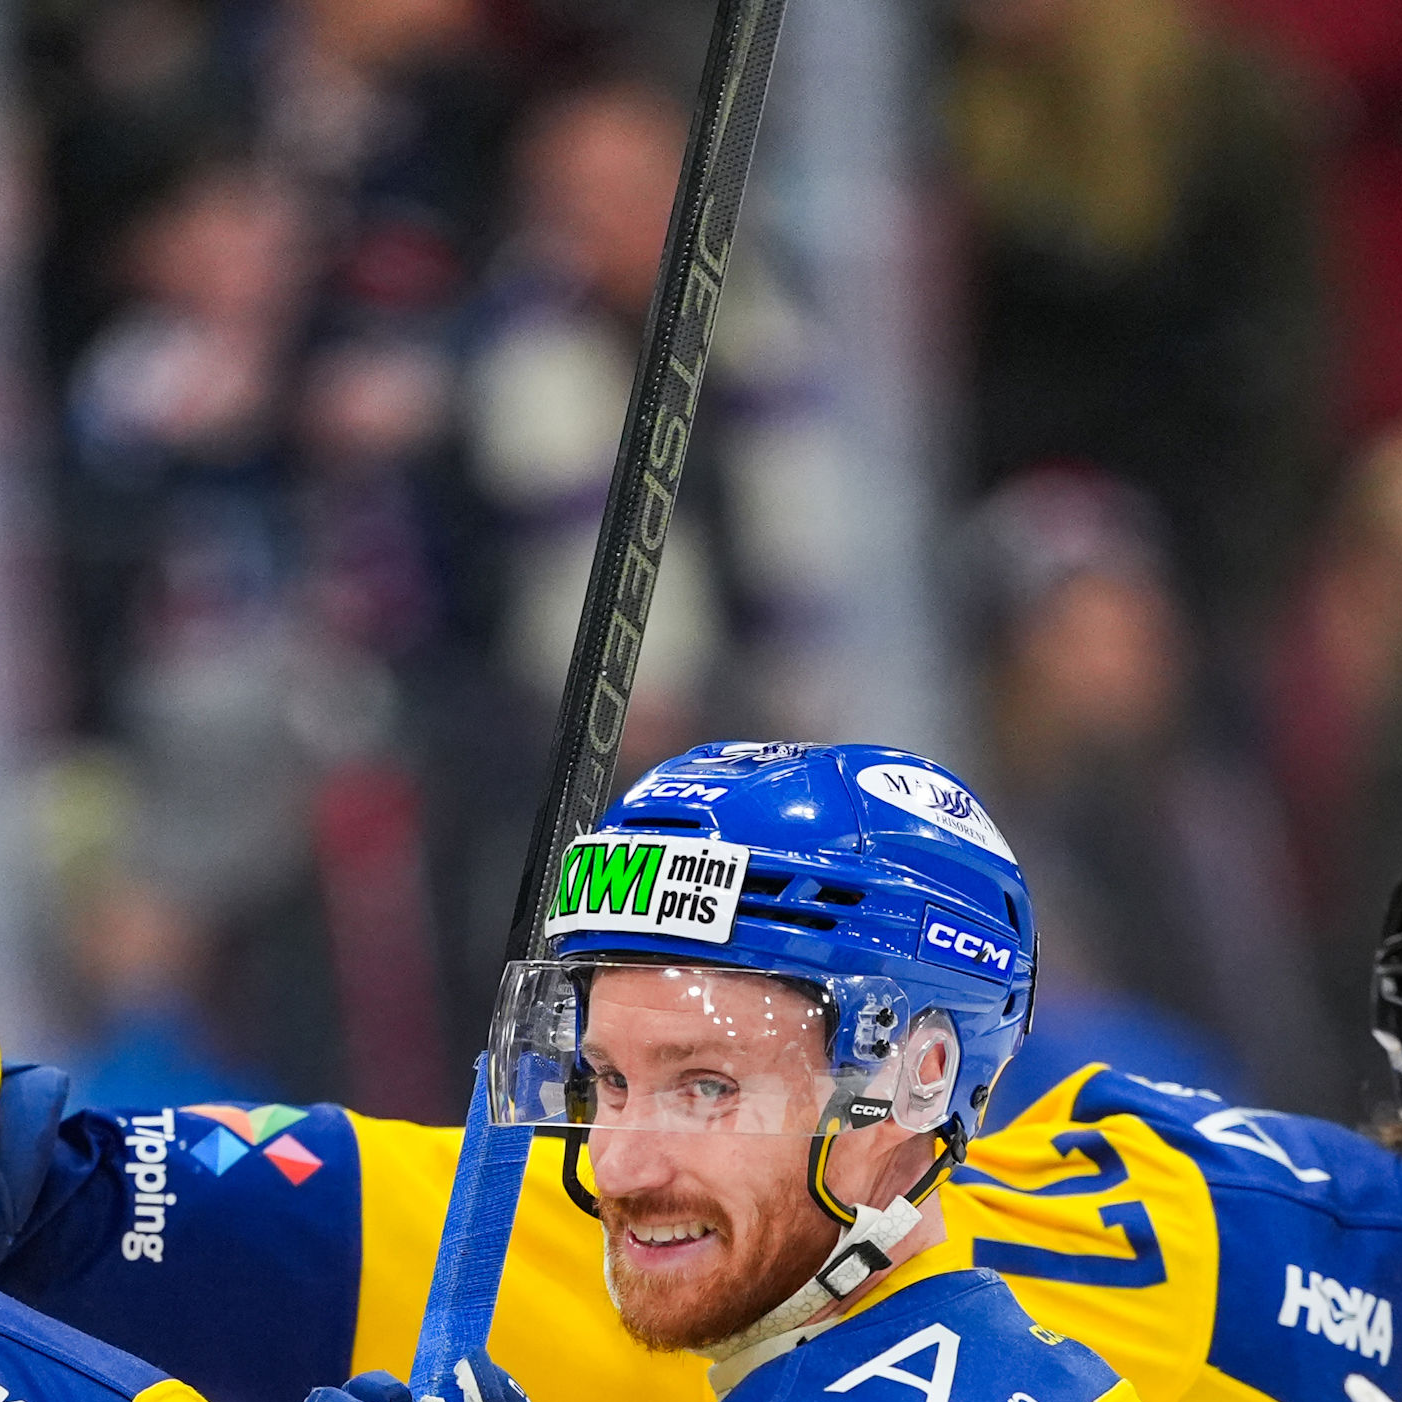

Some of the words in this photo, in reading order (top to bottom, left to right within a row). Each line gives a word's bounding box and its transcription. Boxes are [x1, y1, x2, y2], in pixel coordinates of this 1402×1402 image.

[588, 194, 731, 754] JETSPEED
[623, 782, 728, 804] CCM
[549, 843, 666, 920] KIWI
[667, 850, 738, 889] mini
[656, 886, 718, 925] pris
[927, 921, 1010, 970] CCM
[851, 1104, 888, 1117] CCM
[121, 1107, 177, 1263] Tipping
[1277, 1264, 1394, 1366] HOKA
